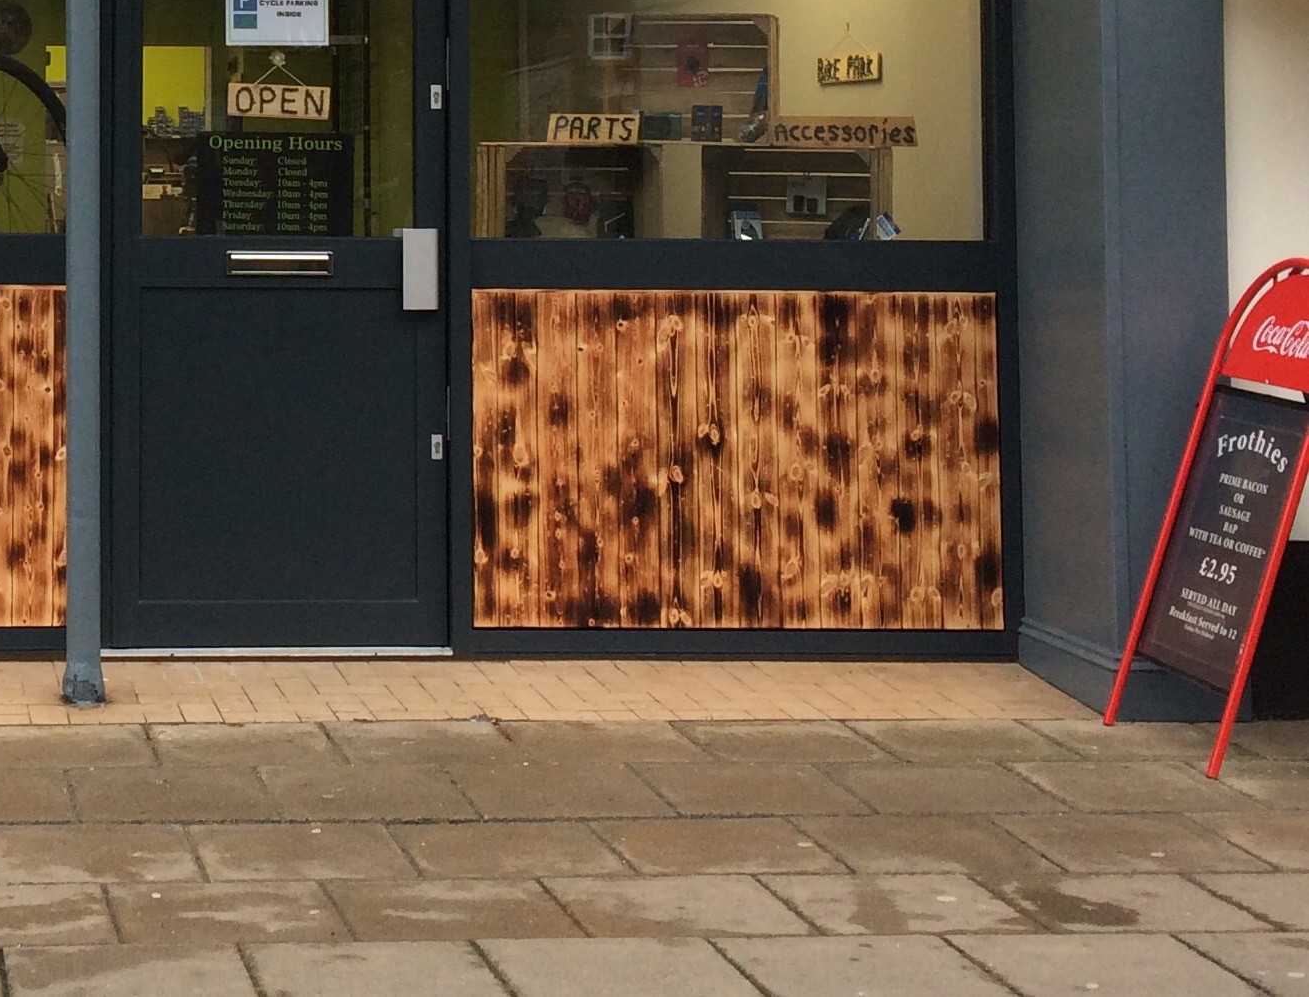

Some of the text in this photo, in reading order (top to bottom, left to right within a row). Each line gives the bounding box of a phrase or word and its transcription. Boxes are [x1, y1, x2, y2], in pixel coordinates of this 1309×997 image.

[235, 86, 325, 117] OPEN
[553, 115, 636, 141] PARTS
[774, 117, 916, 145] Accessories
[209, 135, 343, 152] Opening Hours
[277, 156, 307, 165] Closed
[278, 168, 308, 176] Closed
[1217, 429, 1289, 473] Frothies
[1219, 472, 1269, 495] PRIME BACON
[1233, 492, 1245, 505] OR
[1218, 504, 1251, 522] SAUSAGE
[1189, 526, 1209, 542] WITH
[1209, 533, 1222, 546] TEA
[1223, 537, 1235, 550] OR
[1222, 521, 1239, 535] BAP
[1198, 556, 1238, 585] £2.95
[1181, 587, 1208, 605] SERVED
[1207, 597, 1222, 613] ALL
[1221, 602, 1239, 617] DAY
[1168, 605, 1198, 625] Breakfast
[1198, 614, 1221, 634] Served
[1219, 625, 1228, 637] to
[1227, 627, 1238, 640] 12
